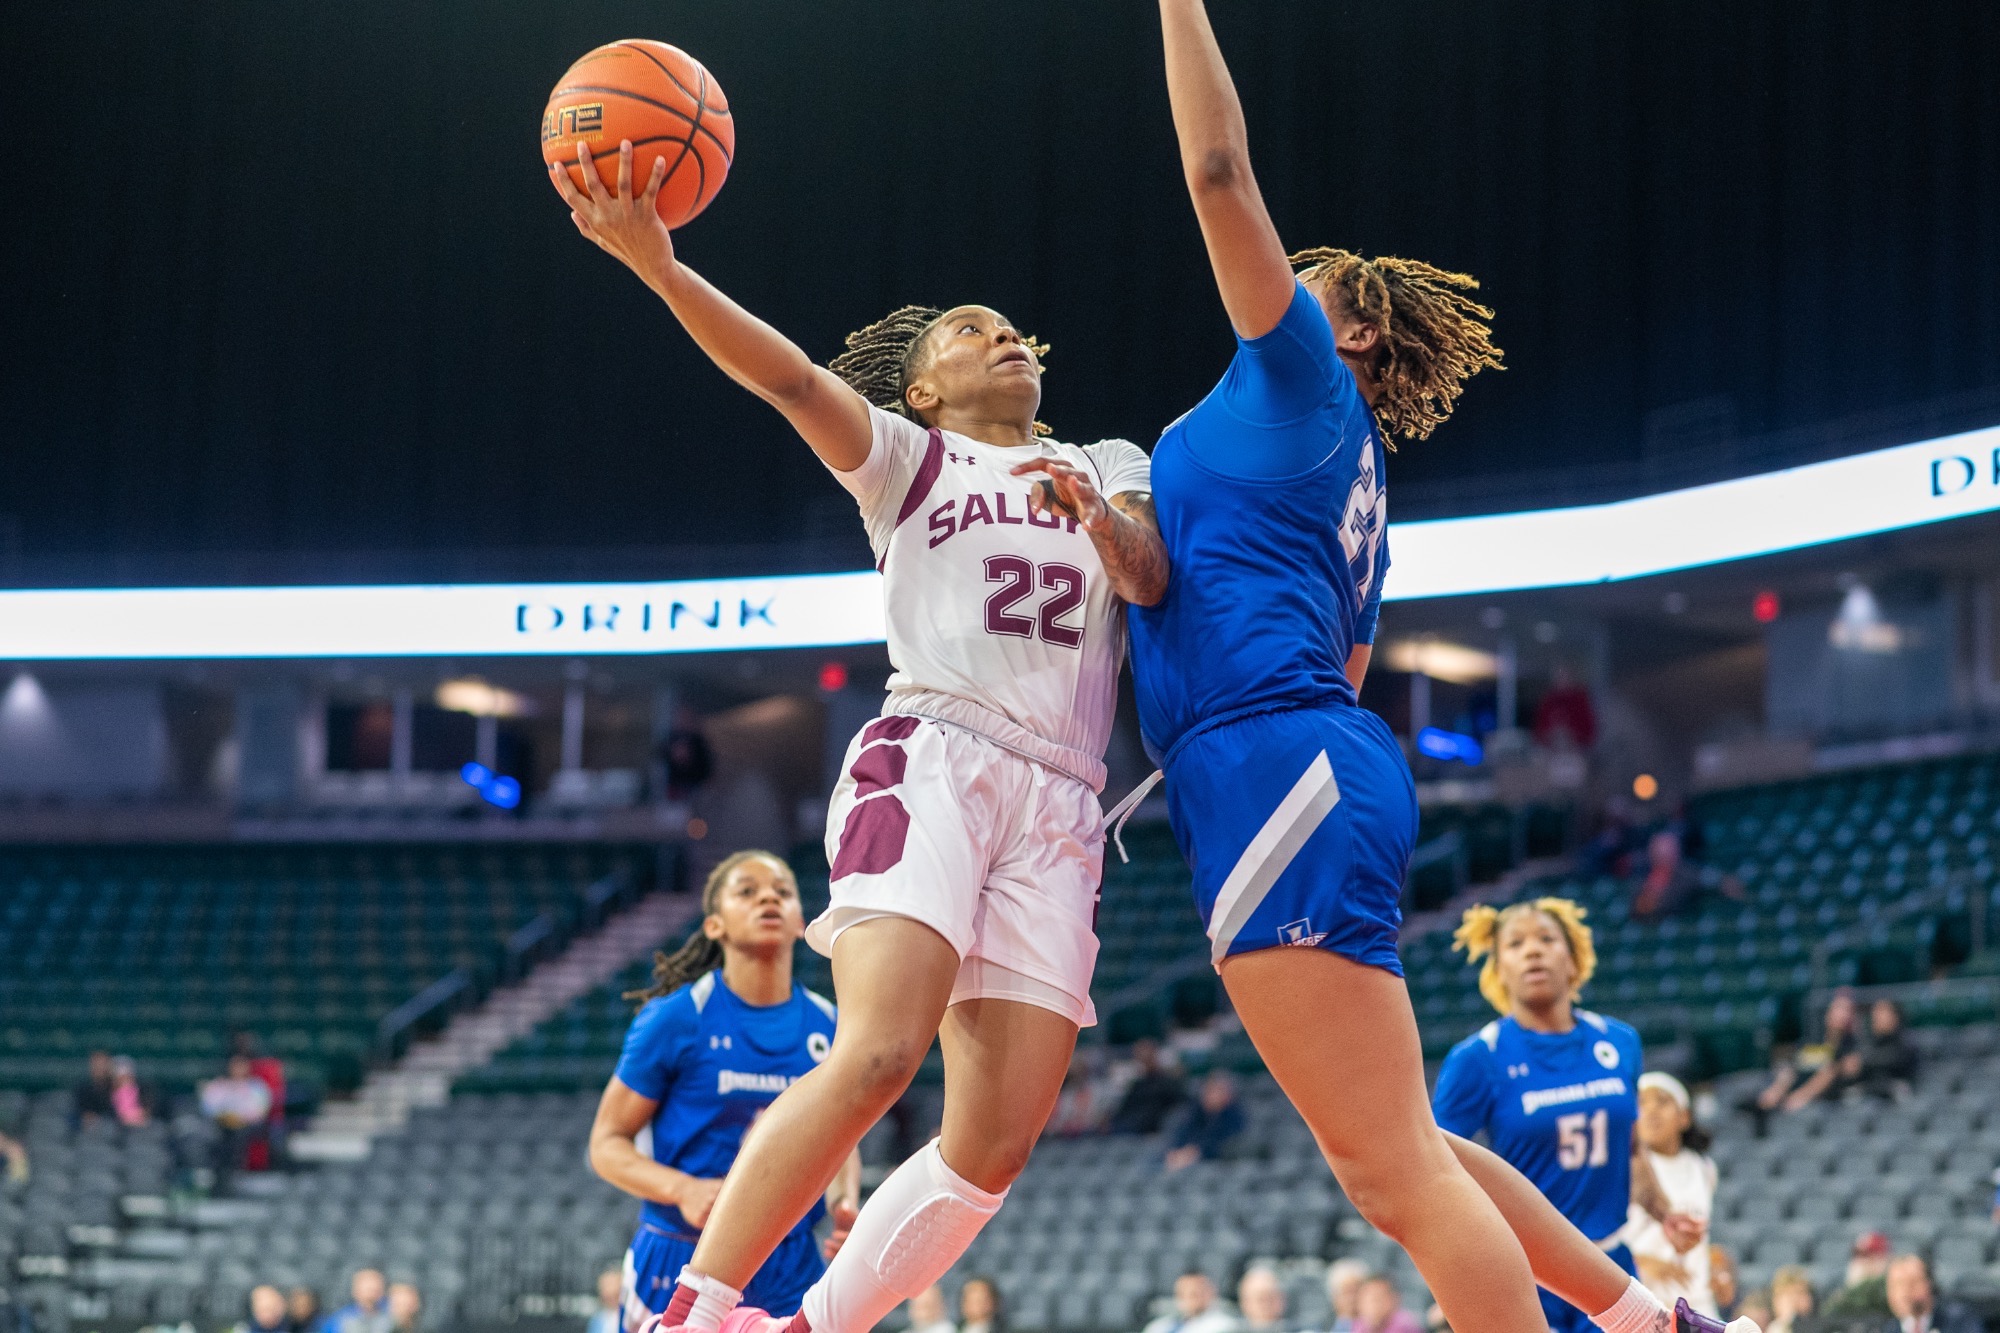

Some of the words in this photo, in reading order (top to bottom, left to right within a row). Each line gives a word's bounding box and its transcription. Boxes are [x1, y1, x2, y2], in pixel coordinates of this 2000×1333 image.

[516, 598, 776, 632] DRINK
[983, 554, 1085, 649] 22
[1556, 1108, 1608, 1170] 51
